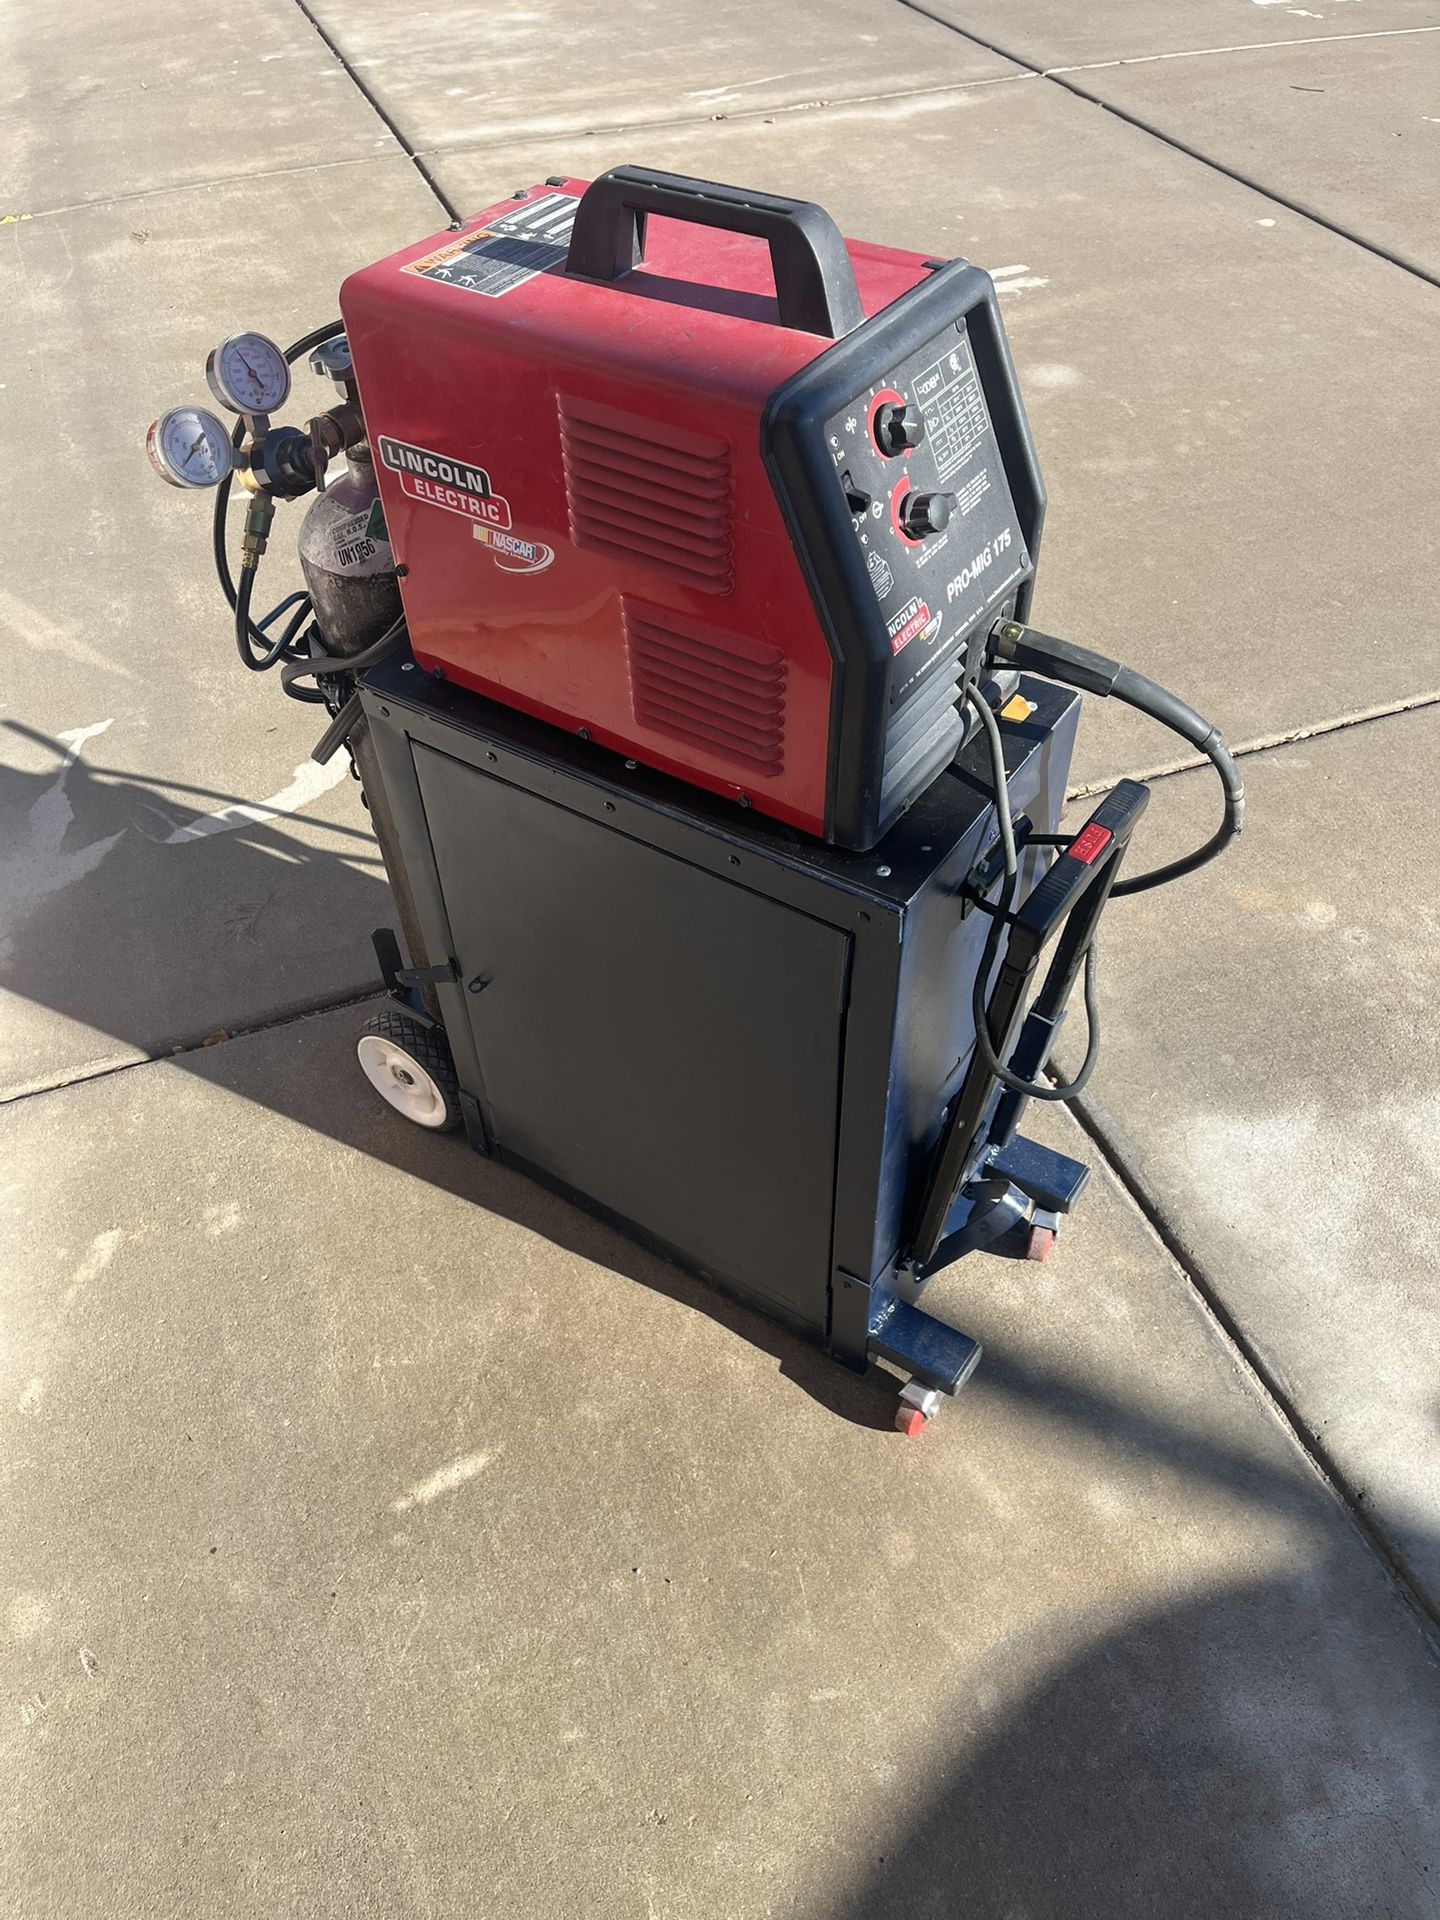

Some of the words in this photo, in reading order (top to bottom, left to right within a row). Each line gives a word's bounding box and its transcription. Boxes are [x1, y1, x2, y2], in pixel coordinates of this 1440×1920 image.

[387, 444, 484, 494] LINCOLN
[413, 478, 500, 522] ELECTRIC
[337, 538, 376, 567] UN1956
[492, 531, 535, 560] NASCAR
[946, 546, 993, 604] PRO-MIG
[993, 527, 1012, 557] 175
[887, 601, 919, 638] NCOLN
[893, 612, 928, 649] ELECTRIC
